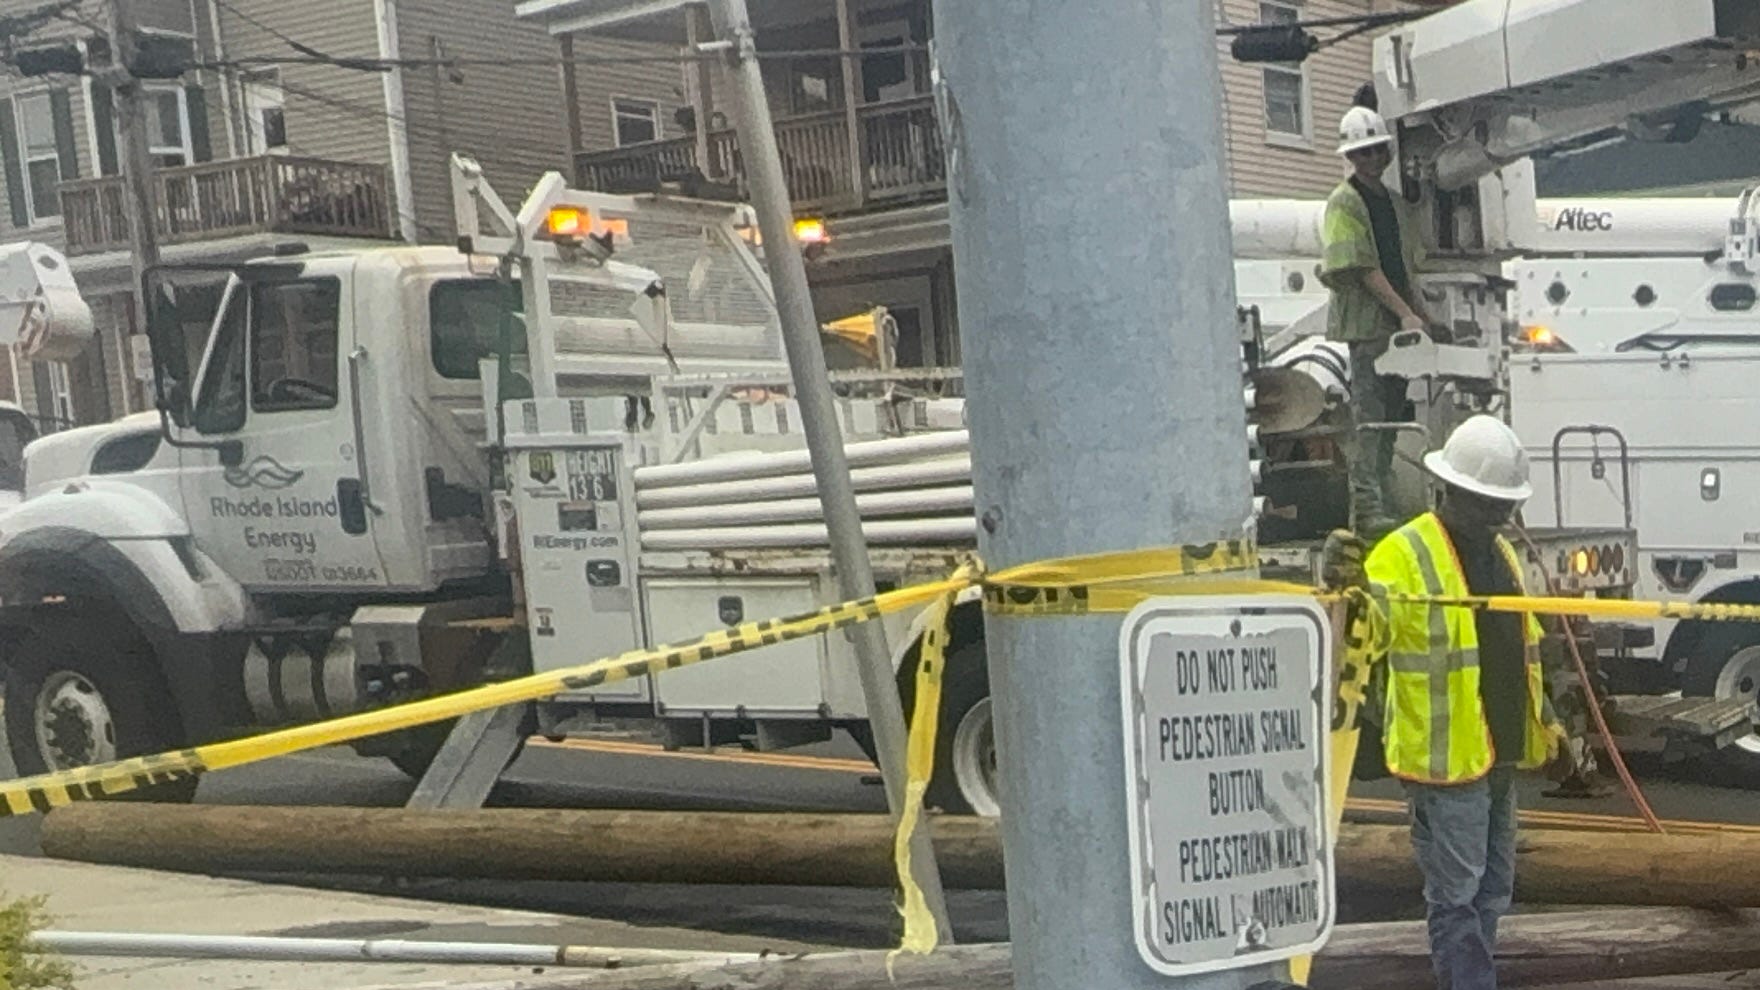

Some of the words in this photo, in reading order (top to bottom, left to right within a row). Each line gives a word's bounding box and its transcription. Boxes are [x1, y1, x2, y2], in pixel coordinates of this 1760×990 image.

[1554, 207, 1613, 232] Altec
[210, 497, 274, 518] Rhode
[277, 496, 338, 518] Island
[244, 526, 317, 554] Energy
[1176, 650, 1200, 695] DO
[1206, 648, 1236, 694] NOT
[1240, 646, 1278, 691] PUSH
[1159, 711, 1256, 762] PEDESTRIAN
[1260, 707, 1306, 754] SIGNAL
[1208, 767, 1265, 816] BUTTON
[1179, 829, 1272, 884] PEDESTRIAN
[1275, 826, 1309, 869] WALK
[1164, 895, 1226, 945] SIGNAL
[1252, 879, 1319, 929] AUTOMATIC
